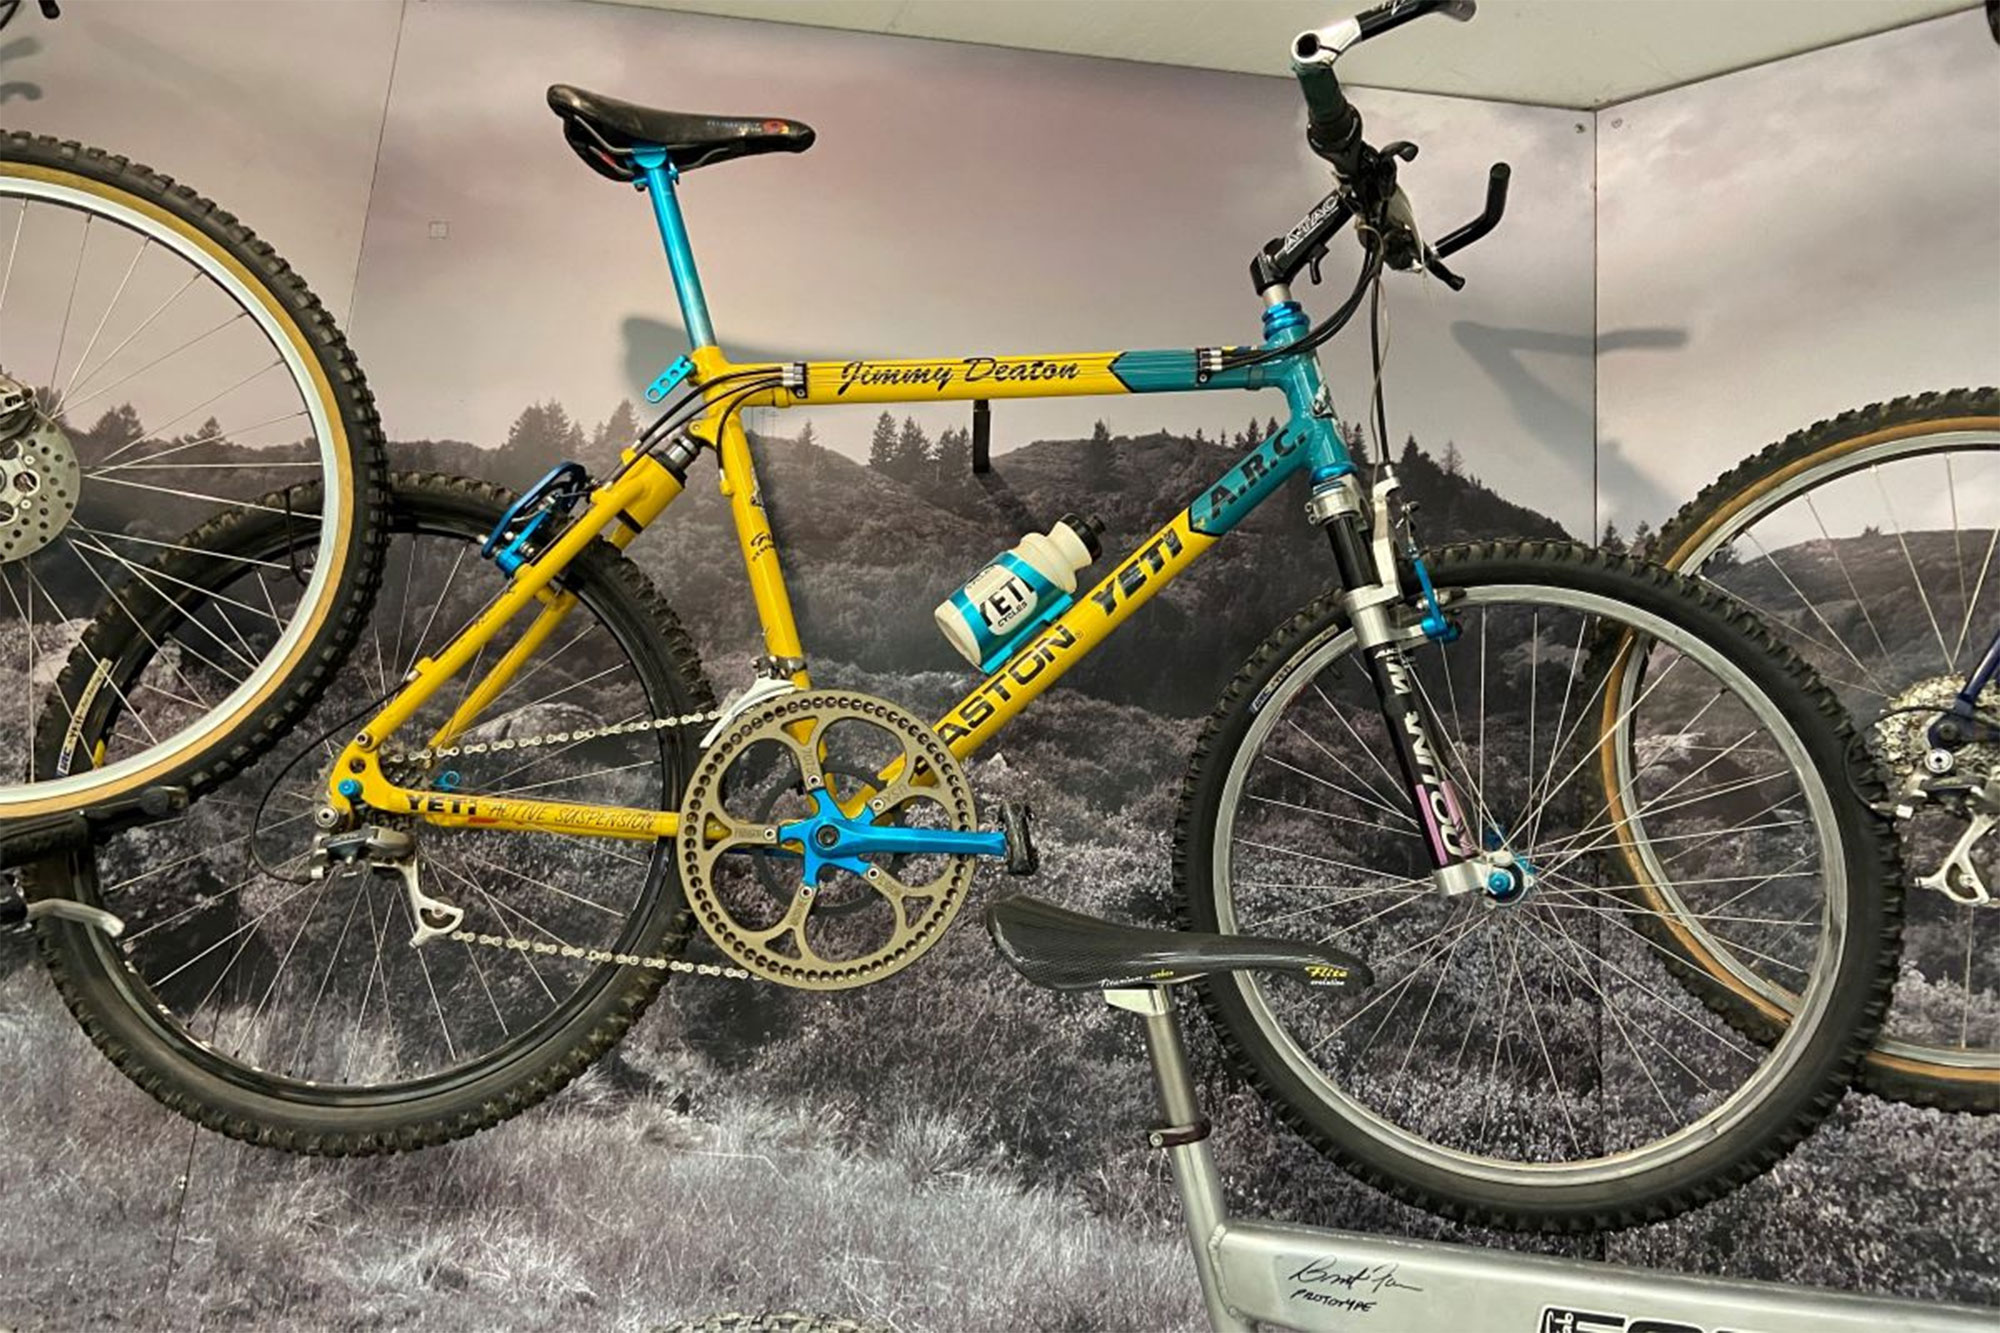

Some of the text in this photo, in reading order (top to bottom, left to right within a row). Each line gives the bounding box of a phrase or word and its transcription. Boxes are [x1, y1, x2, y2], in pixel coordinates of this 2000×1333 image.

[838, 356, 1080, 396] Jimmy Deaton
[1091, 527, 1183, 616] YETI
[1210, 429, 1306, 517] A.R.C.
[998, 601, 1028, 627] CYCLES
[408, 795, 477, 815] YETI
[554, 806, 655, 830] SUSPENSION
[1290, 1288, 1377, 1312] PROTOTYPE
